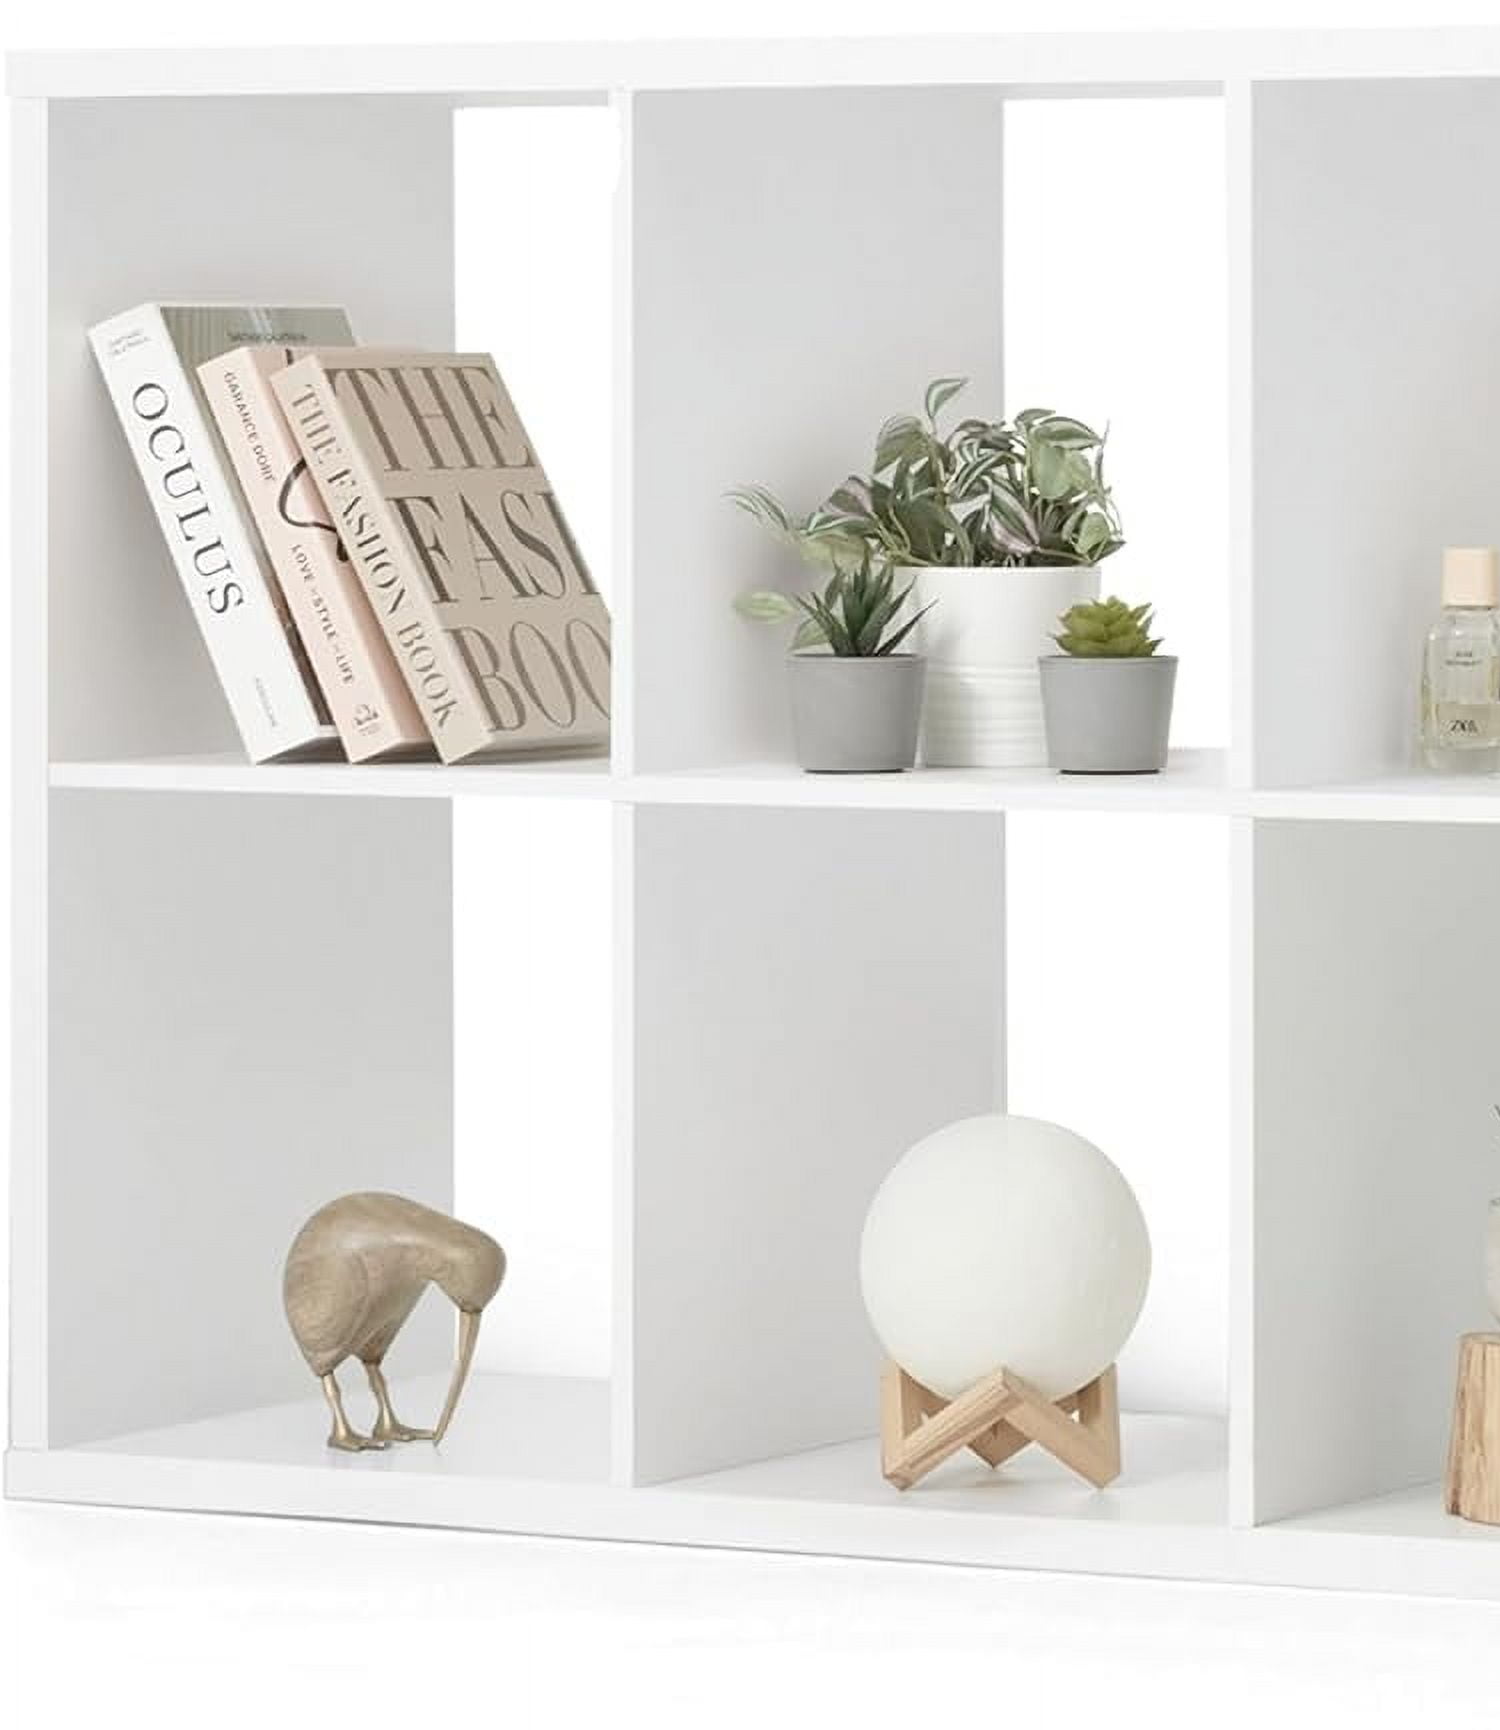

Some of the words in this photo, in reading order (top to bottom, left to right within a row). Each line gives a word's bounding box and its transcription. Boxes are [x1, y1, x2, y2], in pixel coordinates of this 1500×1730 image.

[132, 382, 244, 615] OCULUS
[322, 366, 536, 472] THE
[292, 383, 342, 465] THE
[327, 467, 412, 617] FASHION
[397, 621, 459, 729] BOOK
